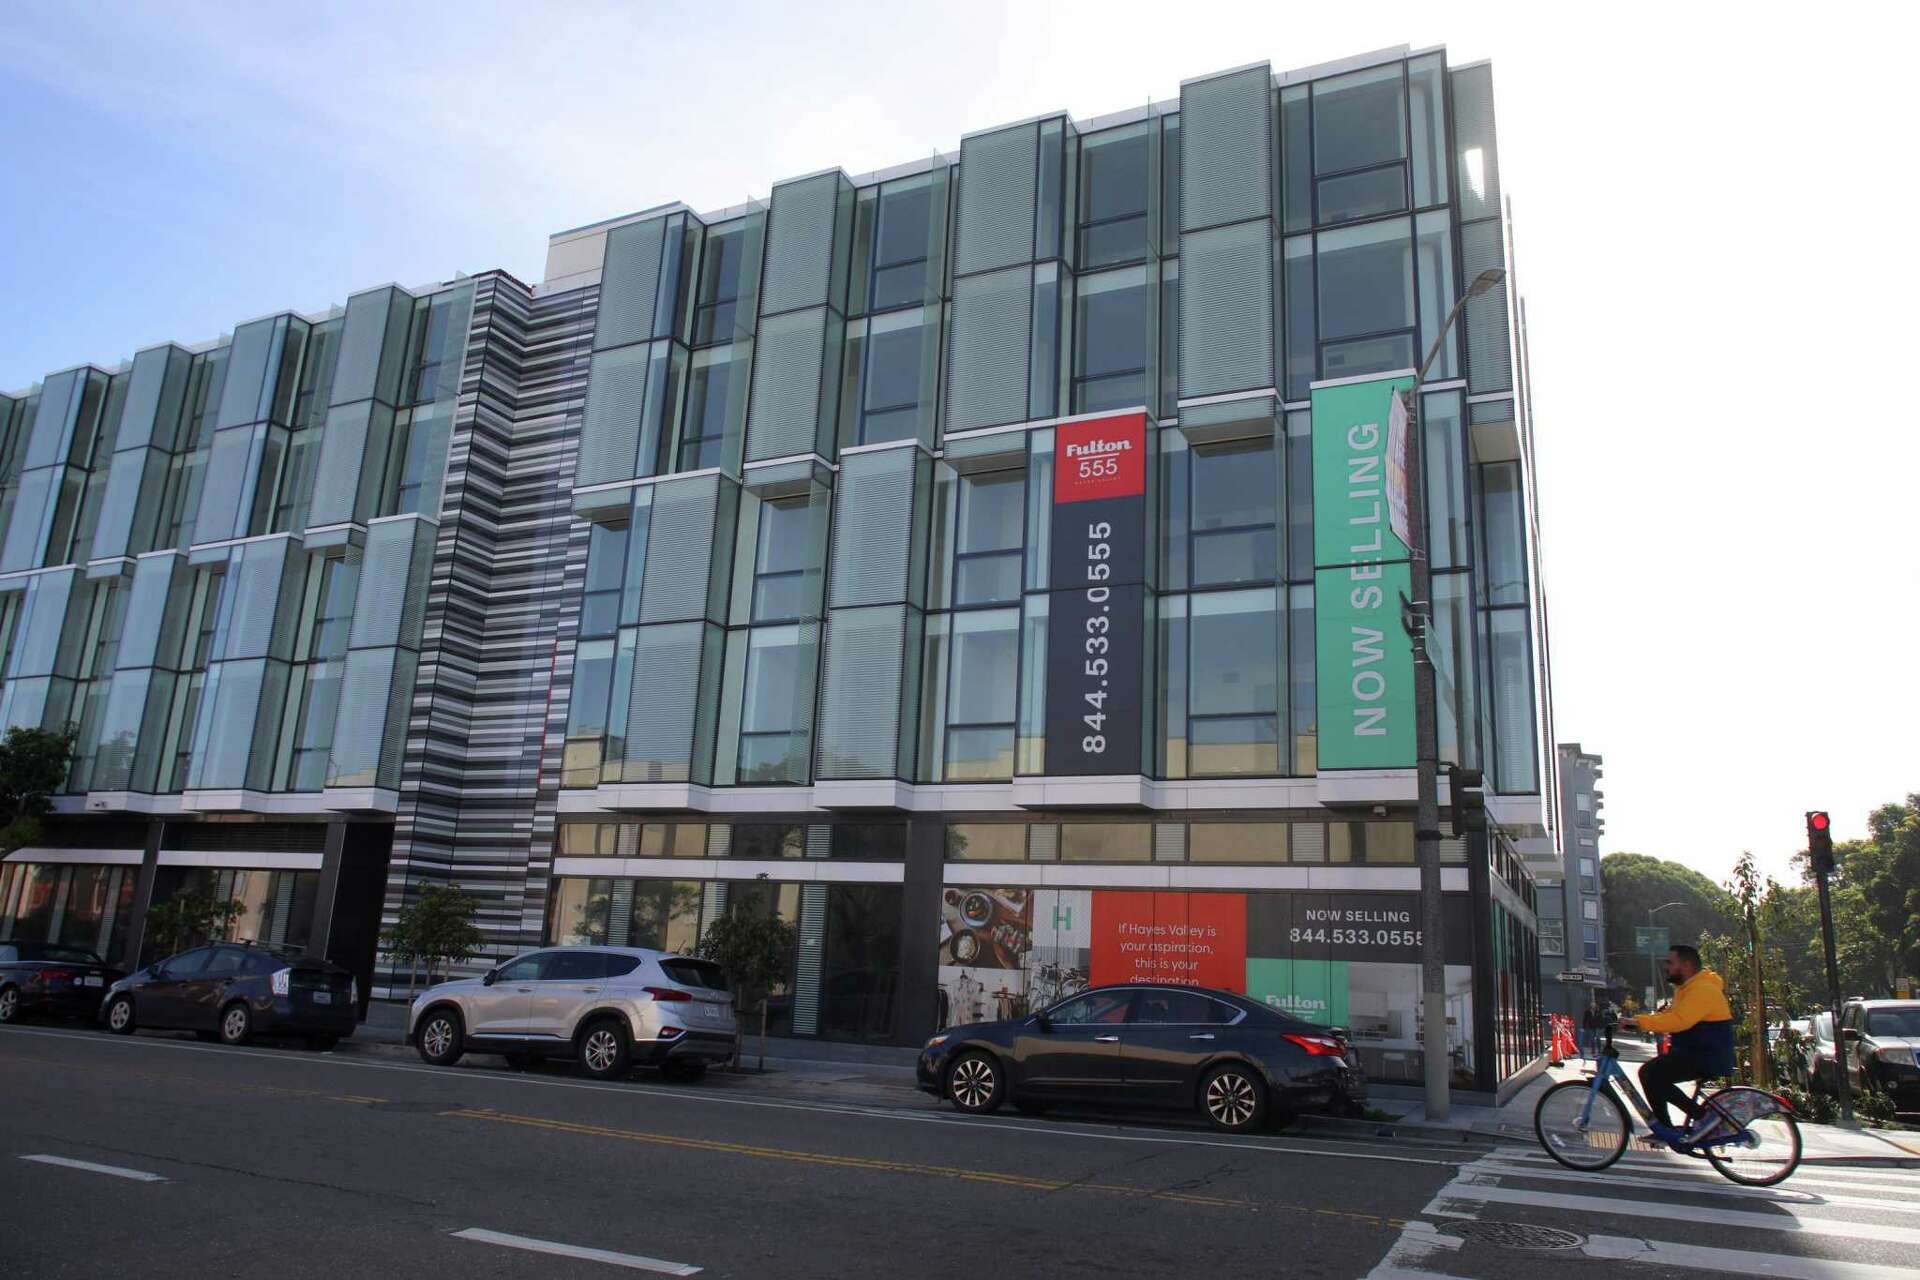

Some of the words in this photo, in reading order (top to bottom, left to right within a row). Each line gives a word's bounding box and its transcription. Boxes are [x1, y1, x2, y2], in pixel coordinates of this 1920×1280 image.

[1066, 439, 1132, 457] Fulton
[1079, 458, 1118, 478] 555
[1347, 423, 1384, 610] SELLING
[1082, 521, 1112, 753] 844.533.0555
[1351, 626, 1387, 736] NOW
[1052, 905, 1072, 931] H
[1306, 909, 1341, 921] NOW
[1345, 910, 1410, 922] SELLING
[1118, 922, 1128, 934] If
[1129, 924, 1166, 937] Hayes
[1207, 925, 1217, 937] is
[1120, 942, 1146, 953] your
[1135, 957, 1157, 969] this
[1160, 958, 1170, 969] is
[1171, 961, 1199, 972] your
[1265, 995, 1327, 1010] Fulton
